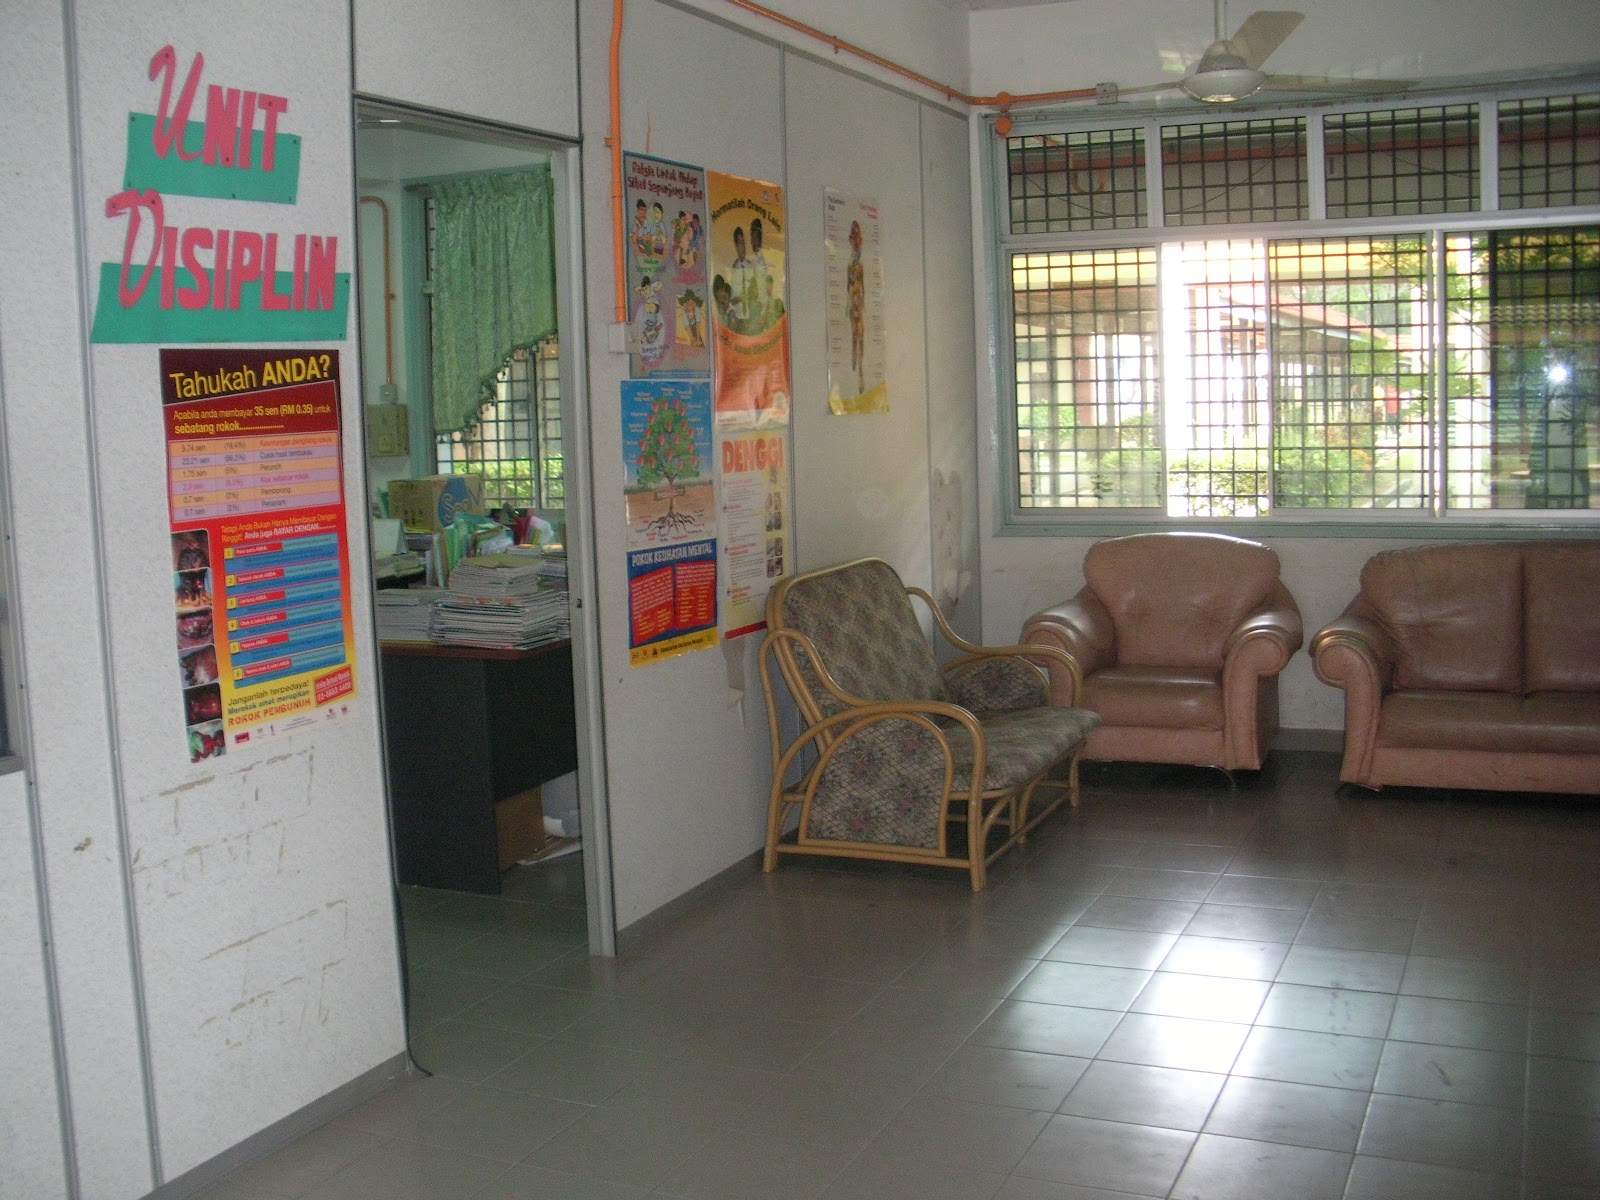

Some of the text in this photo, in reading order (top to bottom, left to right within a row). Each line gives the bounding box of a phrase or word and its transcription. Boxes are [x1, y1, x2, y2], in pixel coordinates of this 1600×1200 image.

[149, 44, 288, 172] UNIT
[747, 199, 766, 219] Orang
[105, 188, 338, 311] DISIPLIN
[169, 355, 330, 398] Tahukah ANDA?
[173, 404, 331, 421] Apabila anda membayar 35 sen (RM 0.35) untuk
[175, 423, 214, 434] sebatang
[722, 437, 785, 474] DENGGI
[244, 531, 259, 539] Anda
[260, 530, 273, 539] juga
[274, 527, 294, 536] BAYAR
[254, 521, 271, 529] Bukan
[632, 551, 653, 567] POKOK
[688, 542, 713, 557] MENTAL
[227, 680, 309, 706] Janganlah terpedaya!
[227, 690, 309, 715] Merokok amat merugikan
[228, 697, 311, 726] ROKOK PEMBUNUH
